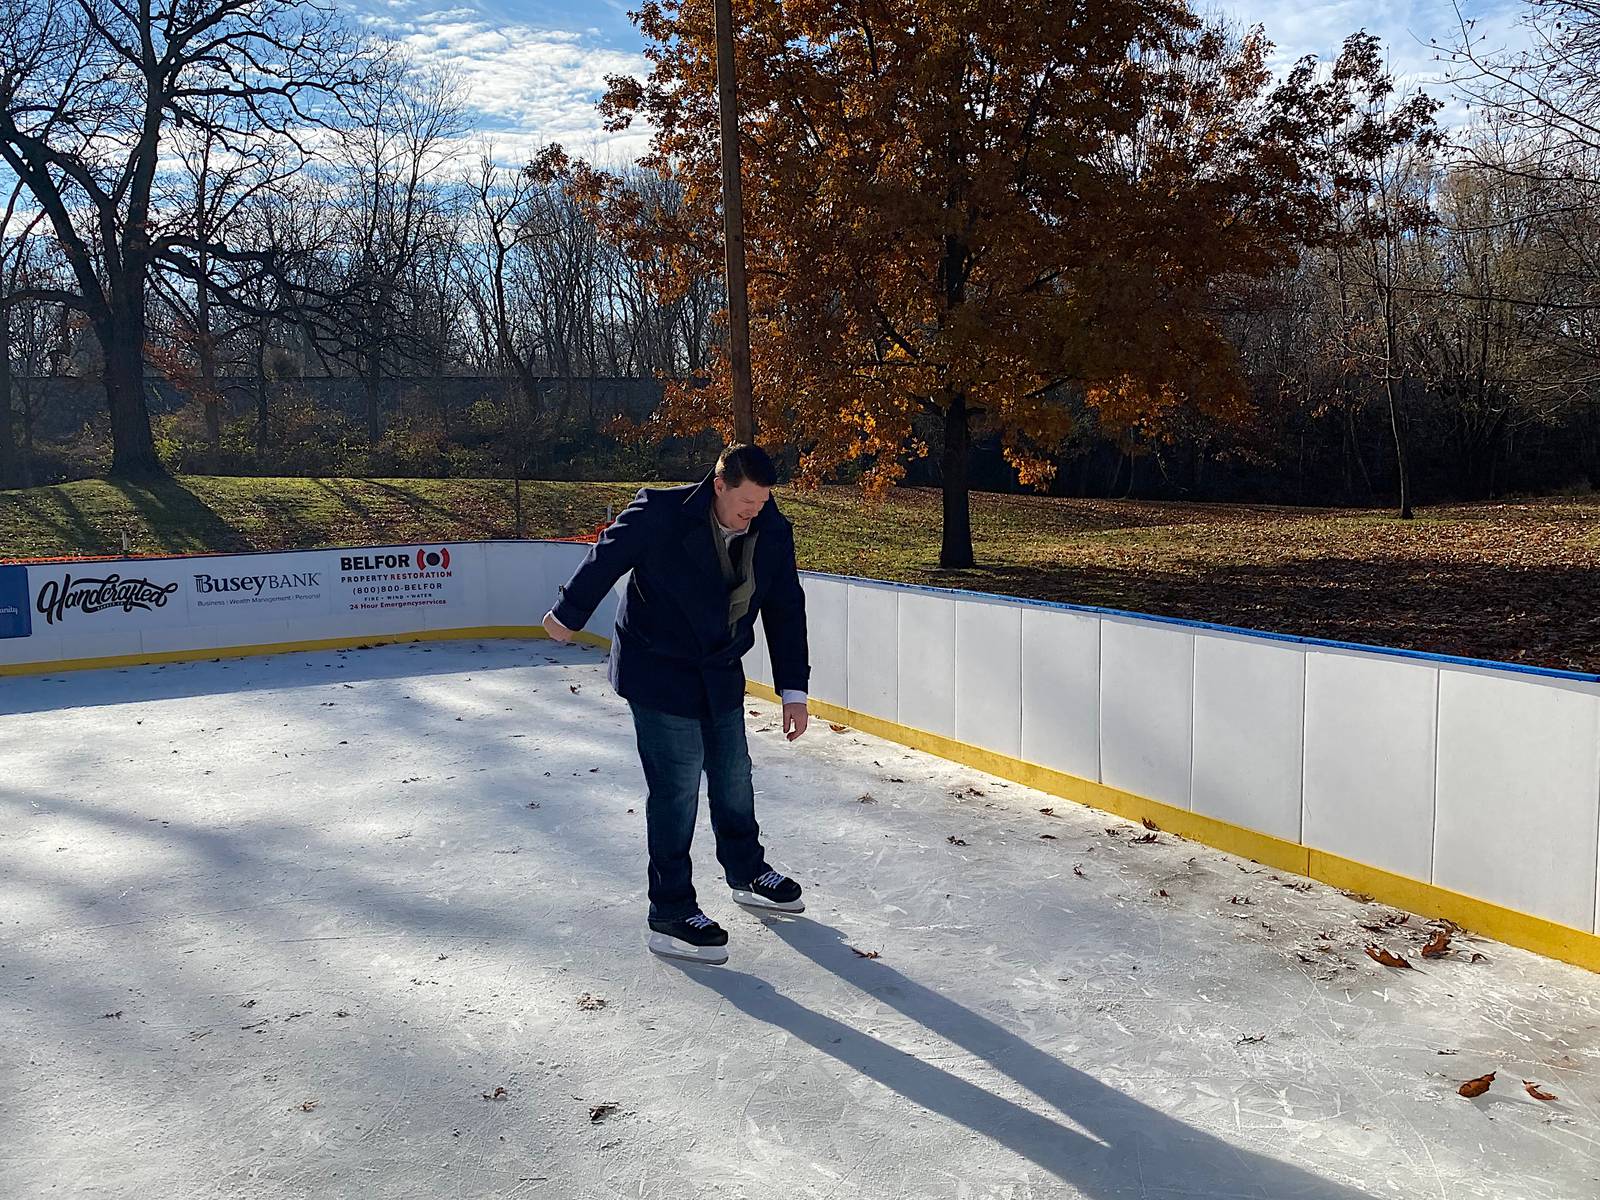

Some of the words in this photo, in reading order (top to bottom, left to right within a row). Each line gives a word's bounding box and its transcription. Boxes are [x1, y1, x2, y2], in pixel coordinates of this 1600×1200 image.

[340, 554, 410, 571] BELFOR
[352, 582, 443, 595] (800)800-BELFOR
[37, 573, 178, 625] Handcrafted
